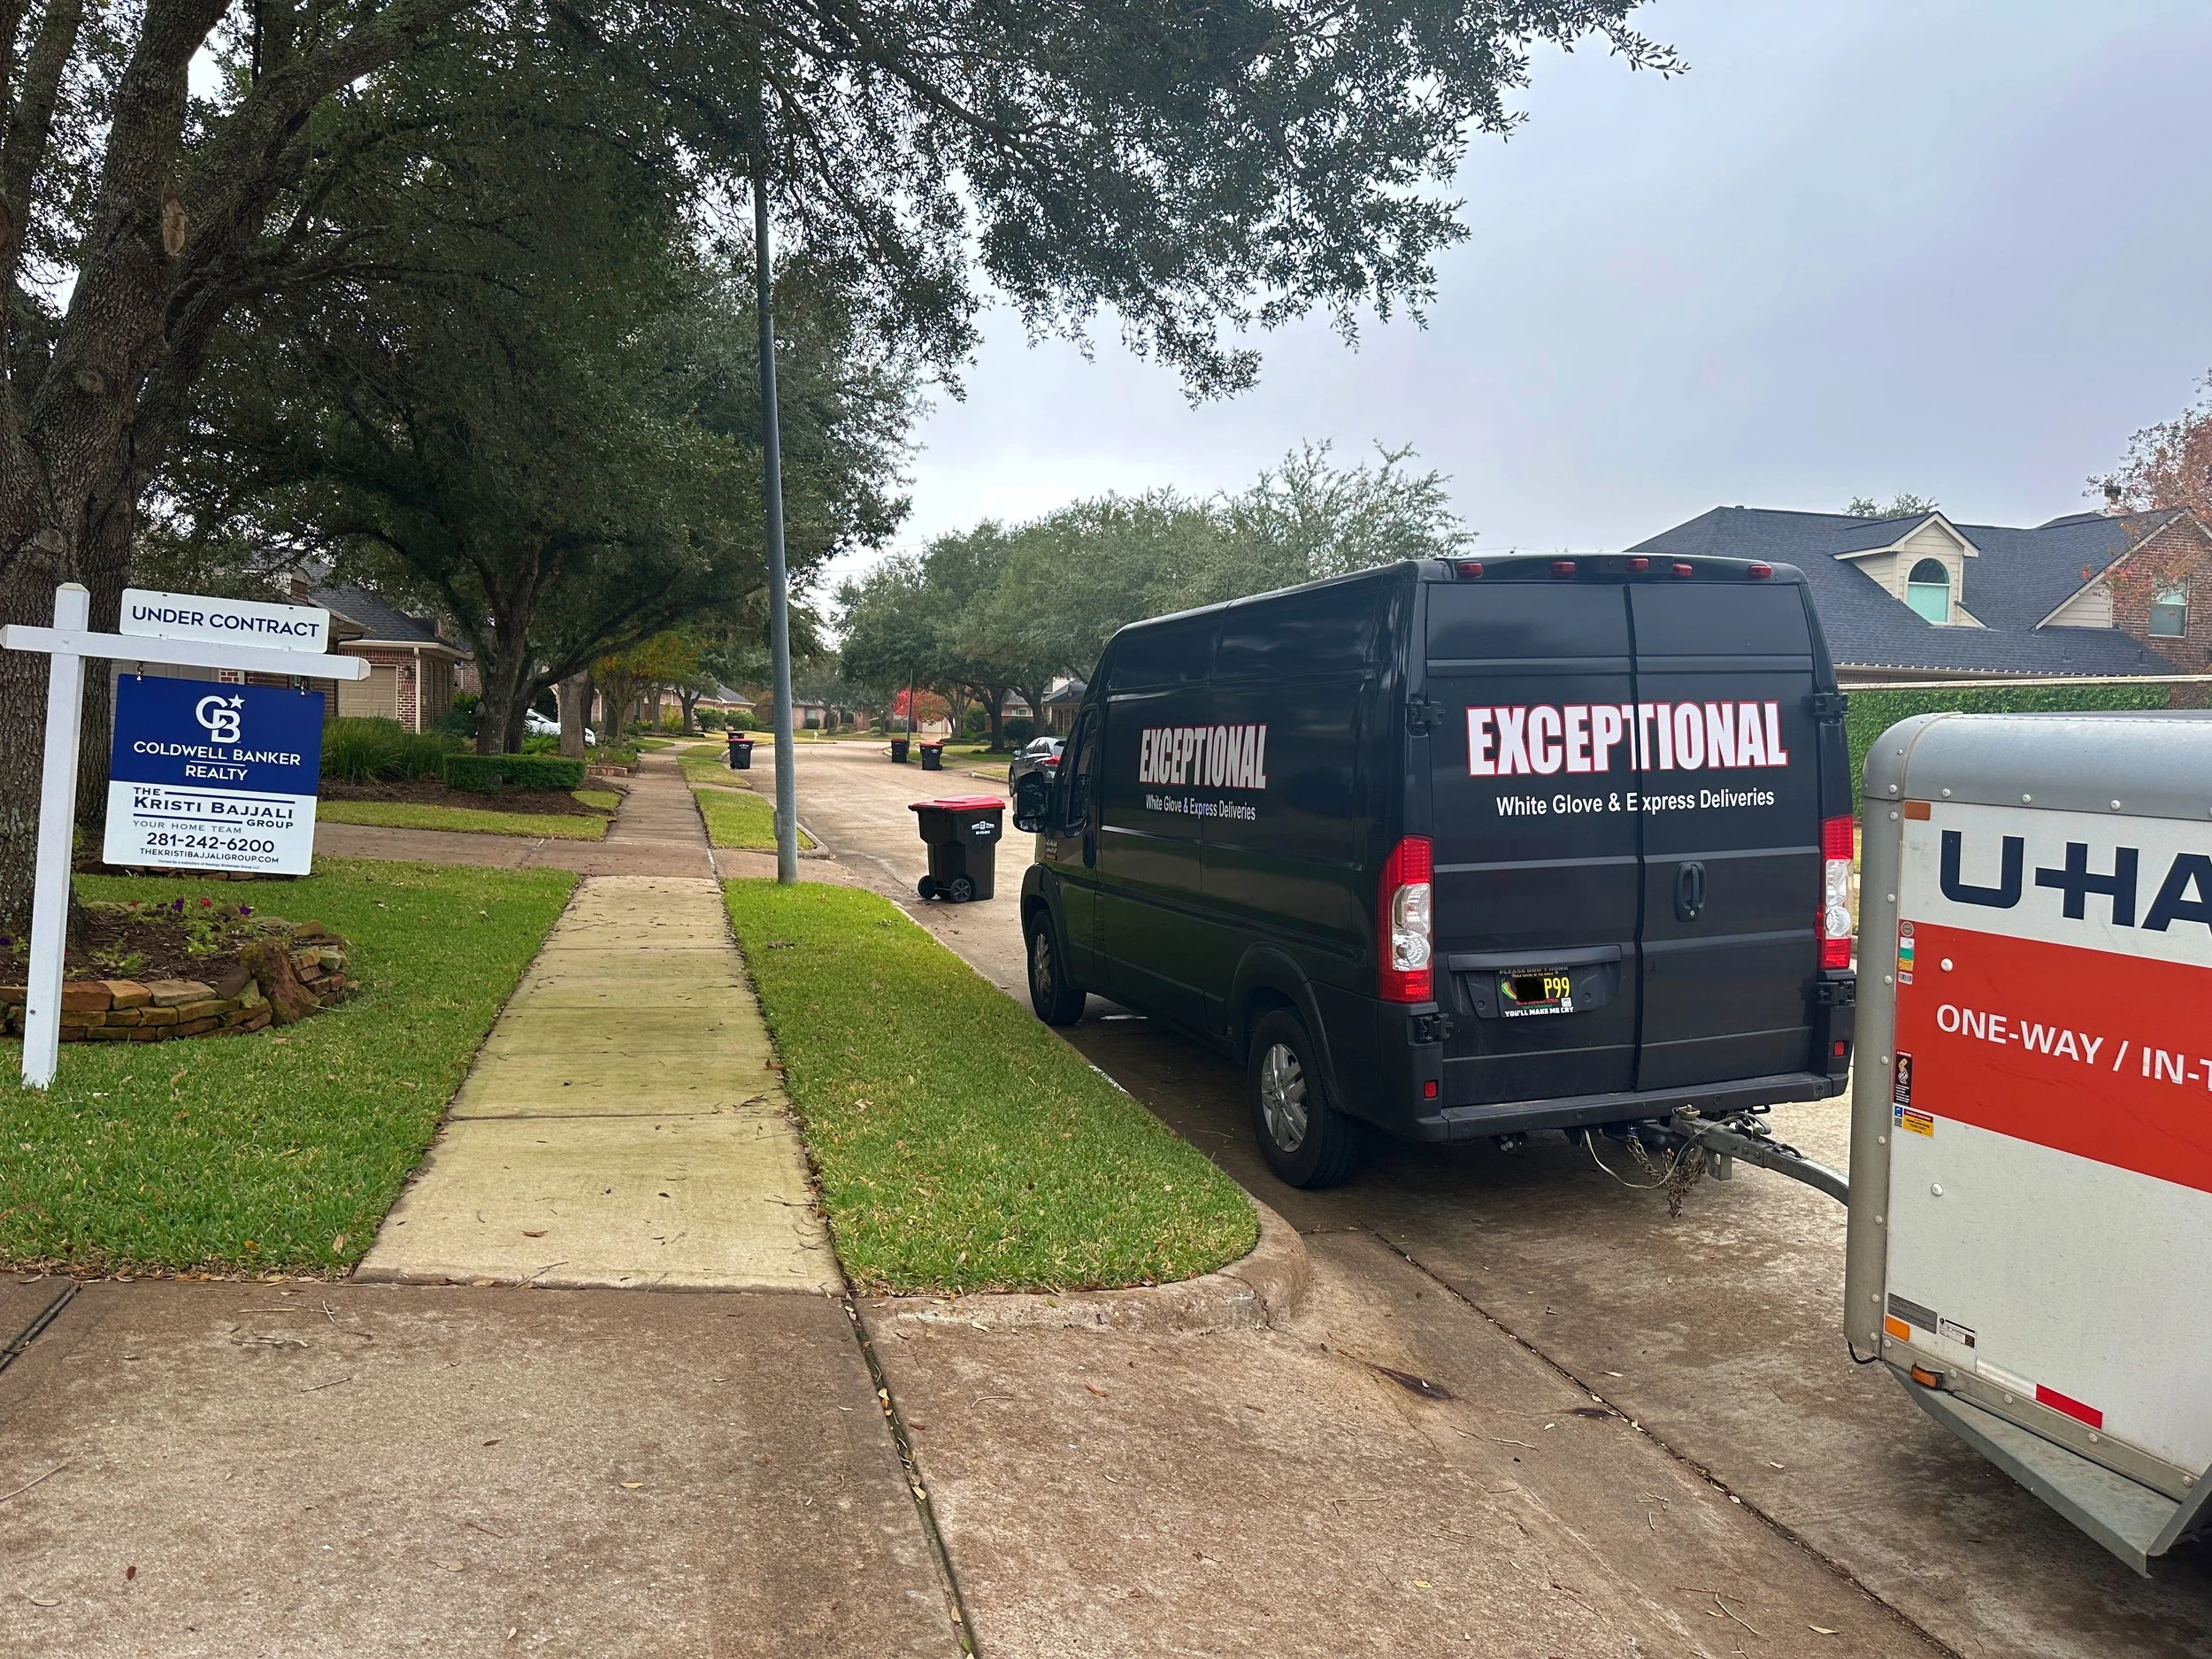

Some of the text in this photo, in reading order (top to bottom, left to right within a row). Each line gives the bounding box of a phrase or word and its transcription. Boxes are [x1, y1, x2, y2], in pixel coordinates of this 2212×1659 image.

[133, 605, 319, 638] UNDER CONTRACT
[1465, 701, 1788, 777] EXCEPTIONAL
[134, 741, 301, 766] COLDWELL BANKER
[1139, 723, 1267, 789] EXCEPTIONAL
[185, 764, 249, 781] REALTY
[134, 787, 161, 796] THE
[1496, 787, 1774, 817] White Glove & Express Deliveries
[134, 796, 293, 819] KRISTI BAJJALI
[1146, 794, 1256, 821] White Glove & Express Deliveries
[134, 820, 165, 829] YOUR
[171, 823, 205, 832] HOME
[246, 819, 294, 829] GROUP
[146, 832, 274, 853] 281-242-6200
[140, 848, 280, 864] THEKRISTIBAJJALIGROUP.COM
[1543, 977, 1570, 999] P99
[1504, 1009, 1528, 1018] YOU'LL
[1936, 1003, 2104, 1065] ONE-WAY
